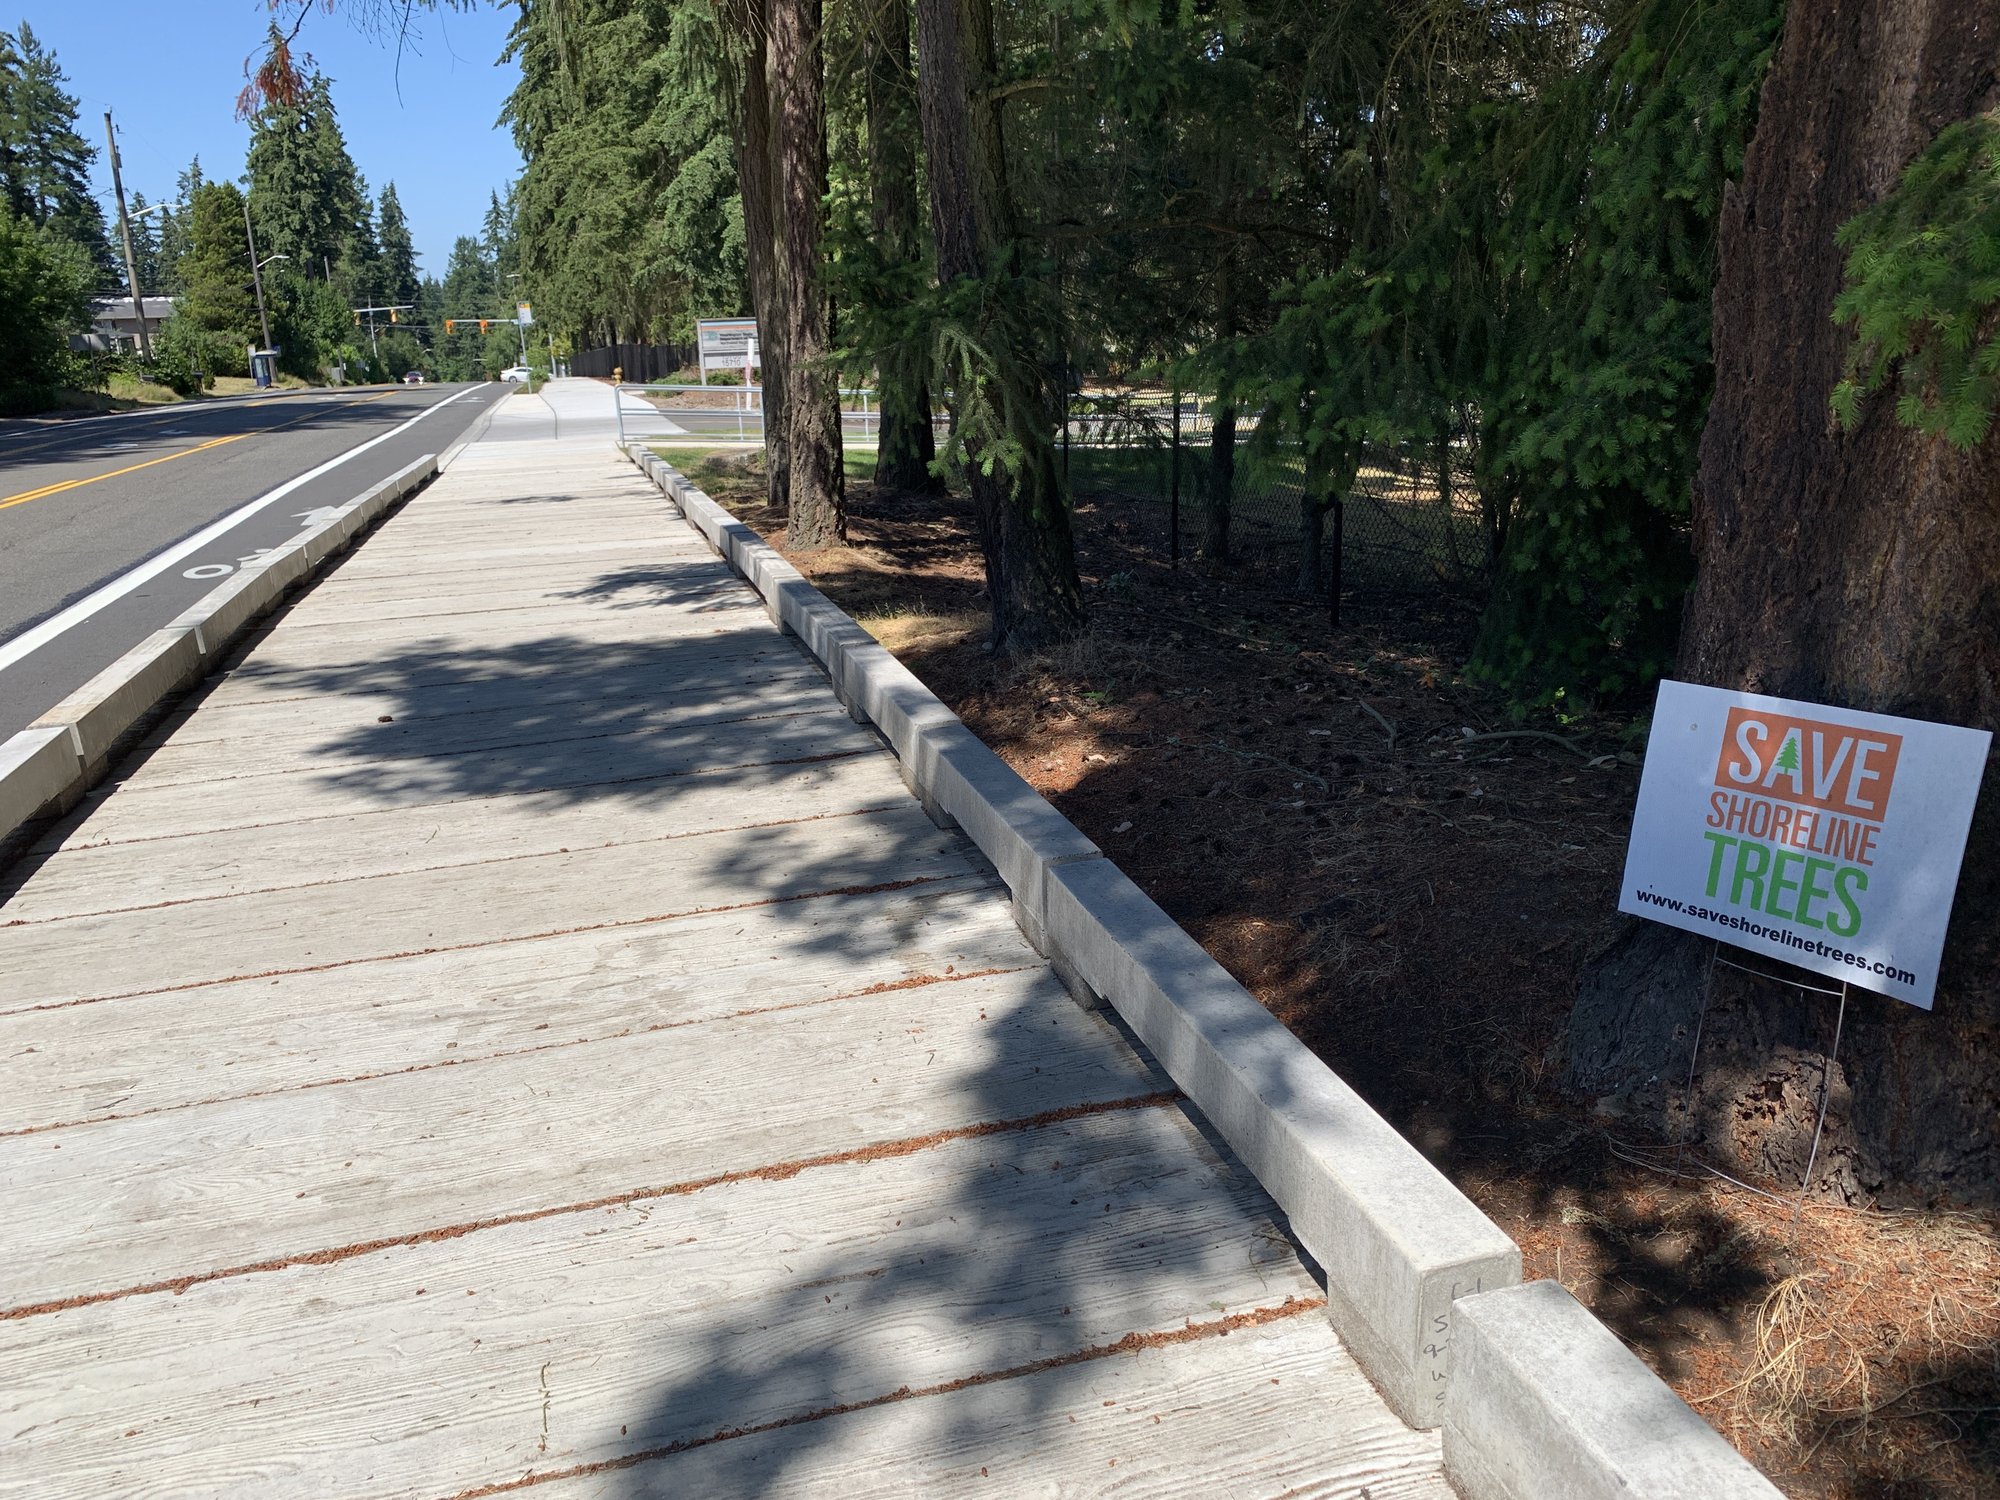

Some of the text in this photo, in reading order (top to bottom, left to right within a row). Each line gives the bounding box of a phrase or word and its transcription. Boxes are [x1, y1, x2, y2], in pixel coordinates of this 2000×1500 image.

[1728, 720, 1888, 811] SAVE
[1706, 791, 1881, 867] SHORELINE
[1703, 831, 1869, 938] TREES
[1636, 889, 1916, 986] www.saveshorelinetrees.com
